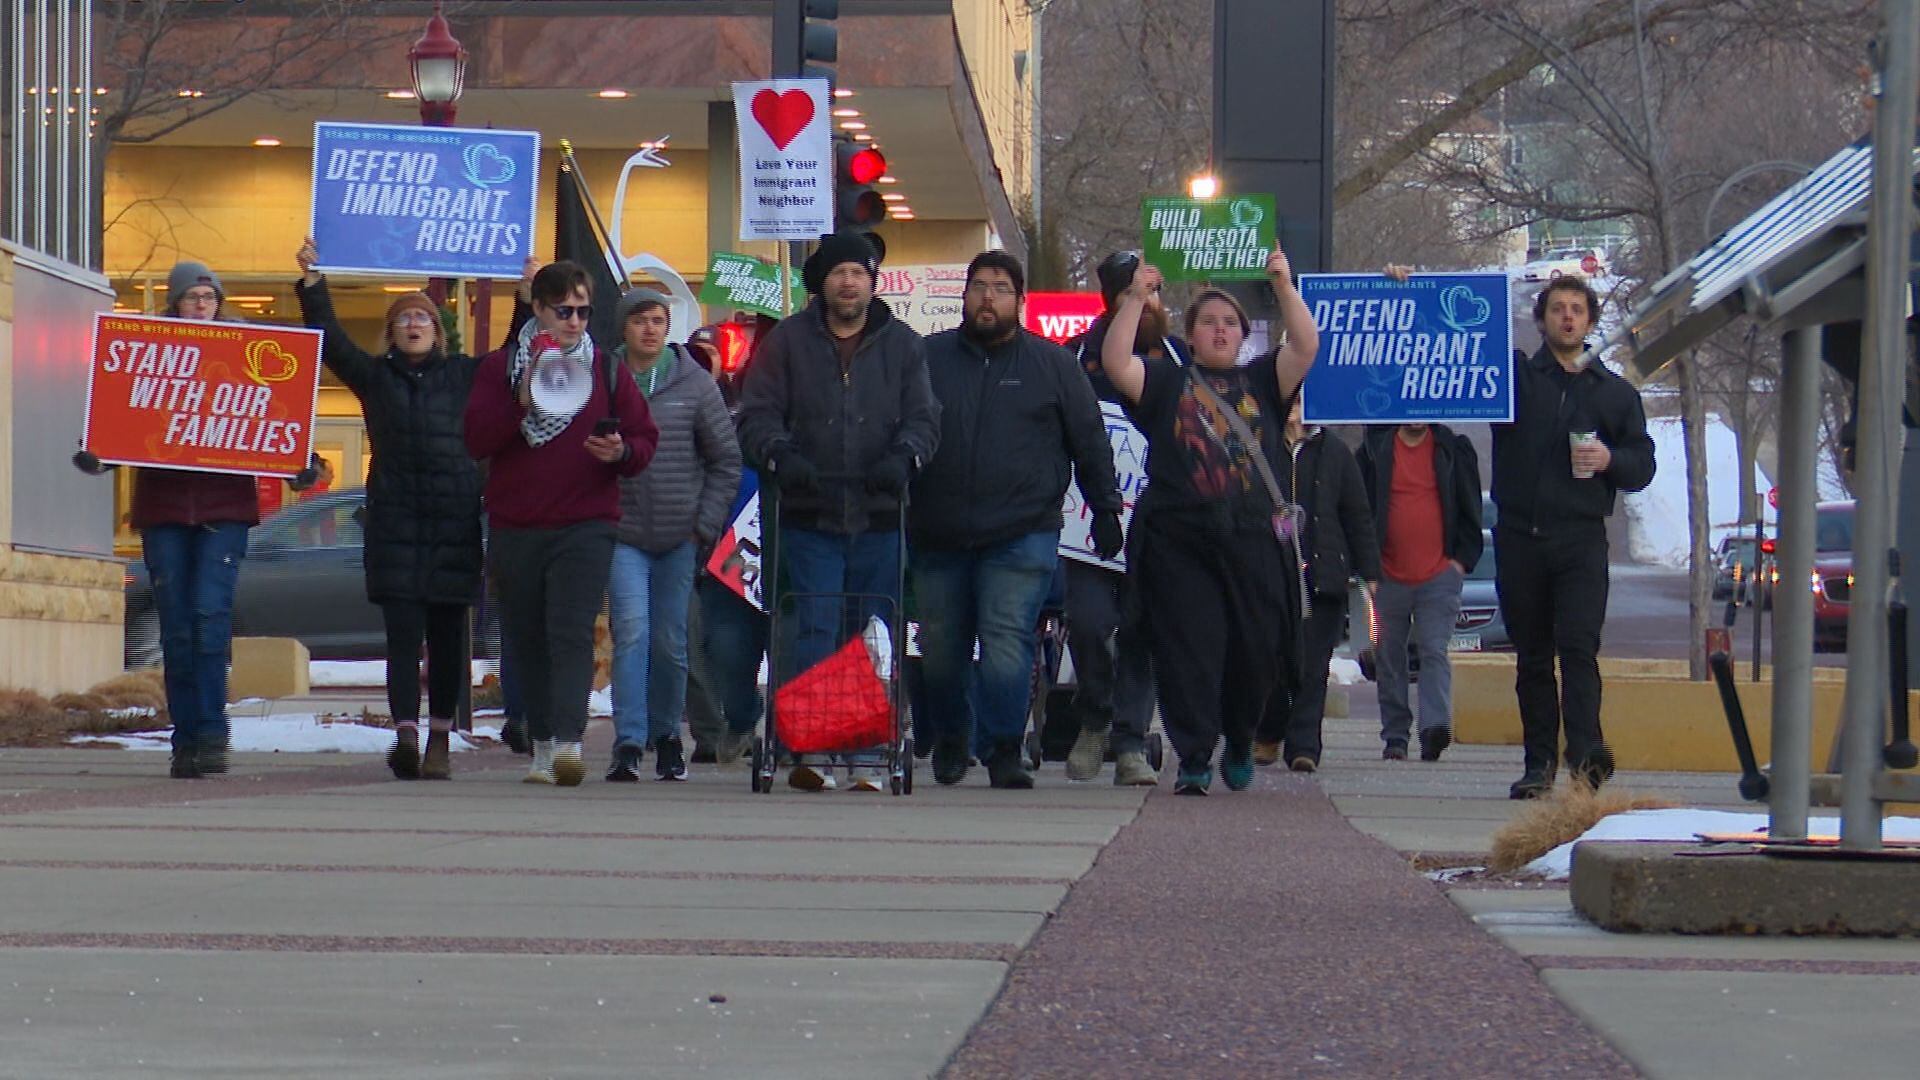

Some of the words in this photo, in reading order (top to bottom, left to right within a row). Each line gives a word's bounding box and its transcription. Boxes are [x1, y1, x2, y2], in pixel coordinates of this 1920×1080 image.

[325, 130, 359, 140] STAND
[362, 131, 390, 142] WITH
[392, 132, 462, 145] IMMIGRANTS
[326, 149, 438, 184] DEFEND
[755, 158, 782, 170] Love
[785, 158, 818, 170] Your
[753, 176, 817, 190] Immigrant
[341, 183, 511, 221] IMMIGRANT
[758, 194, 816, 207] Neighbor
[1150, 208, 1201, 230] BUILD
[415, 219, 522, 256] RIGHTS
[1160, 227, 1258, 250] MINNESOTA
[712, 260, 754, 276] BUILD
[1183, 248, 1269, 270] TOGETHER
[714, 274, 783, 298] MINNESOT
[1306, 281, 1339, 291] STAND
[1343, 280, 1369, 290] WITH
[1371, 280, 1437, 290] IMMIGRANTS
[727, 287, 794, 312] TOGETHE
[1314, 299, 1416, 332] DEFEND
[104, 321, 140, 333] STAND
[143, 324, 171, 335] WITH
[173, 326, 244, 341] IMMIGRANTS
[103, 339, 201, 378] STAND
[1328, 332, 1487, 366] IMMIGRANT
[1401, 365, 1500, 400] RIGHTS
[128, 375, 207, 414] WITH
[211, 382, 273, 419] OUR
[163, 414, 302, 455] FAMILIES
